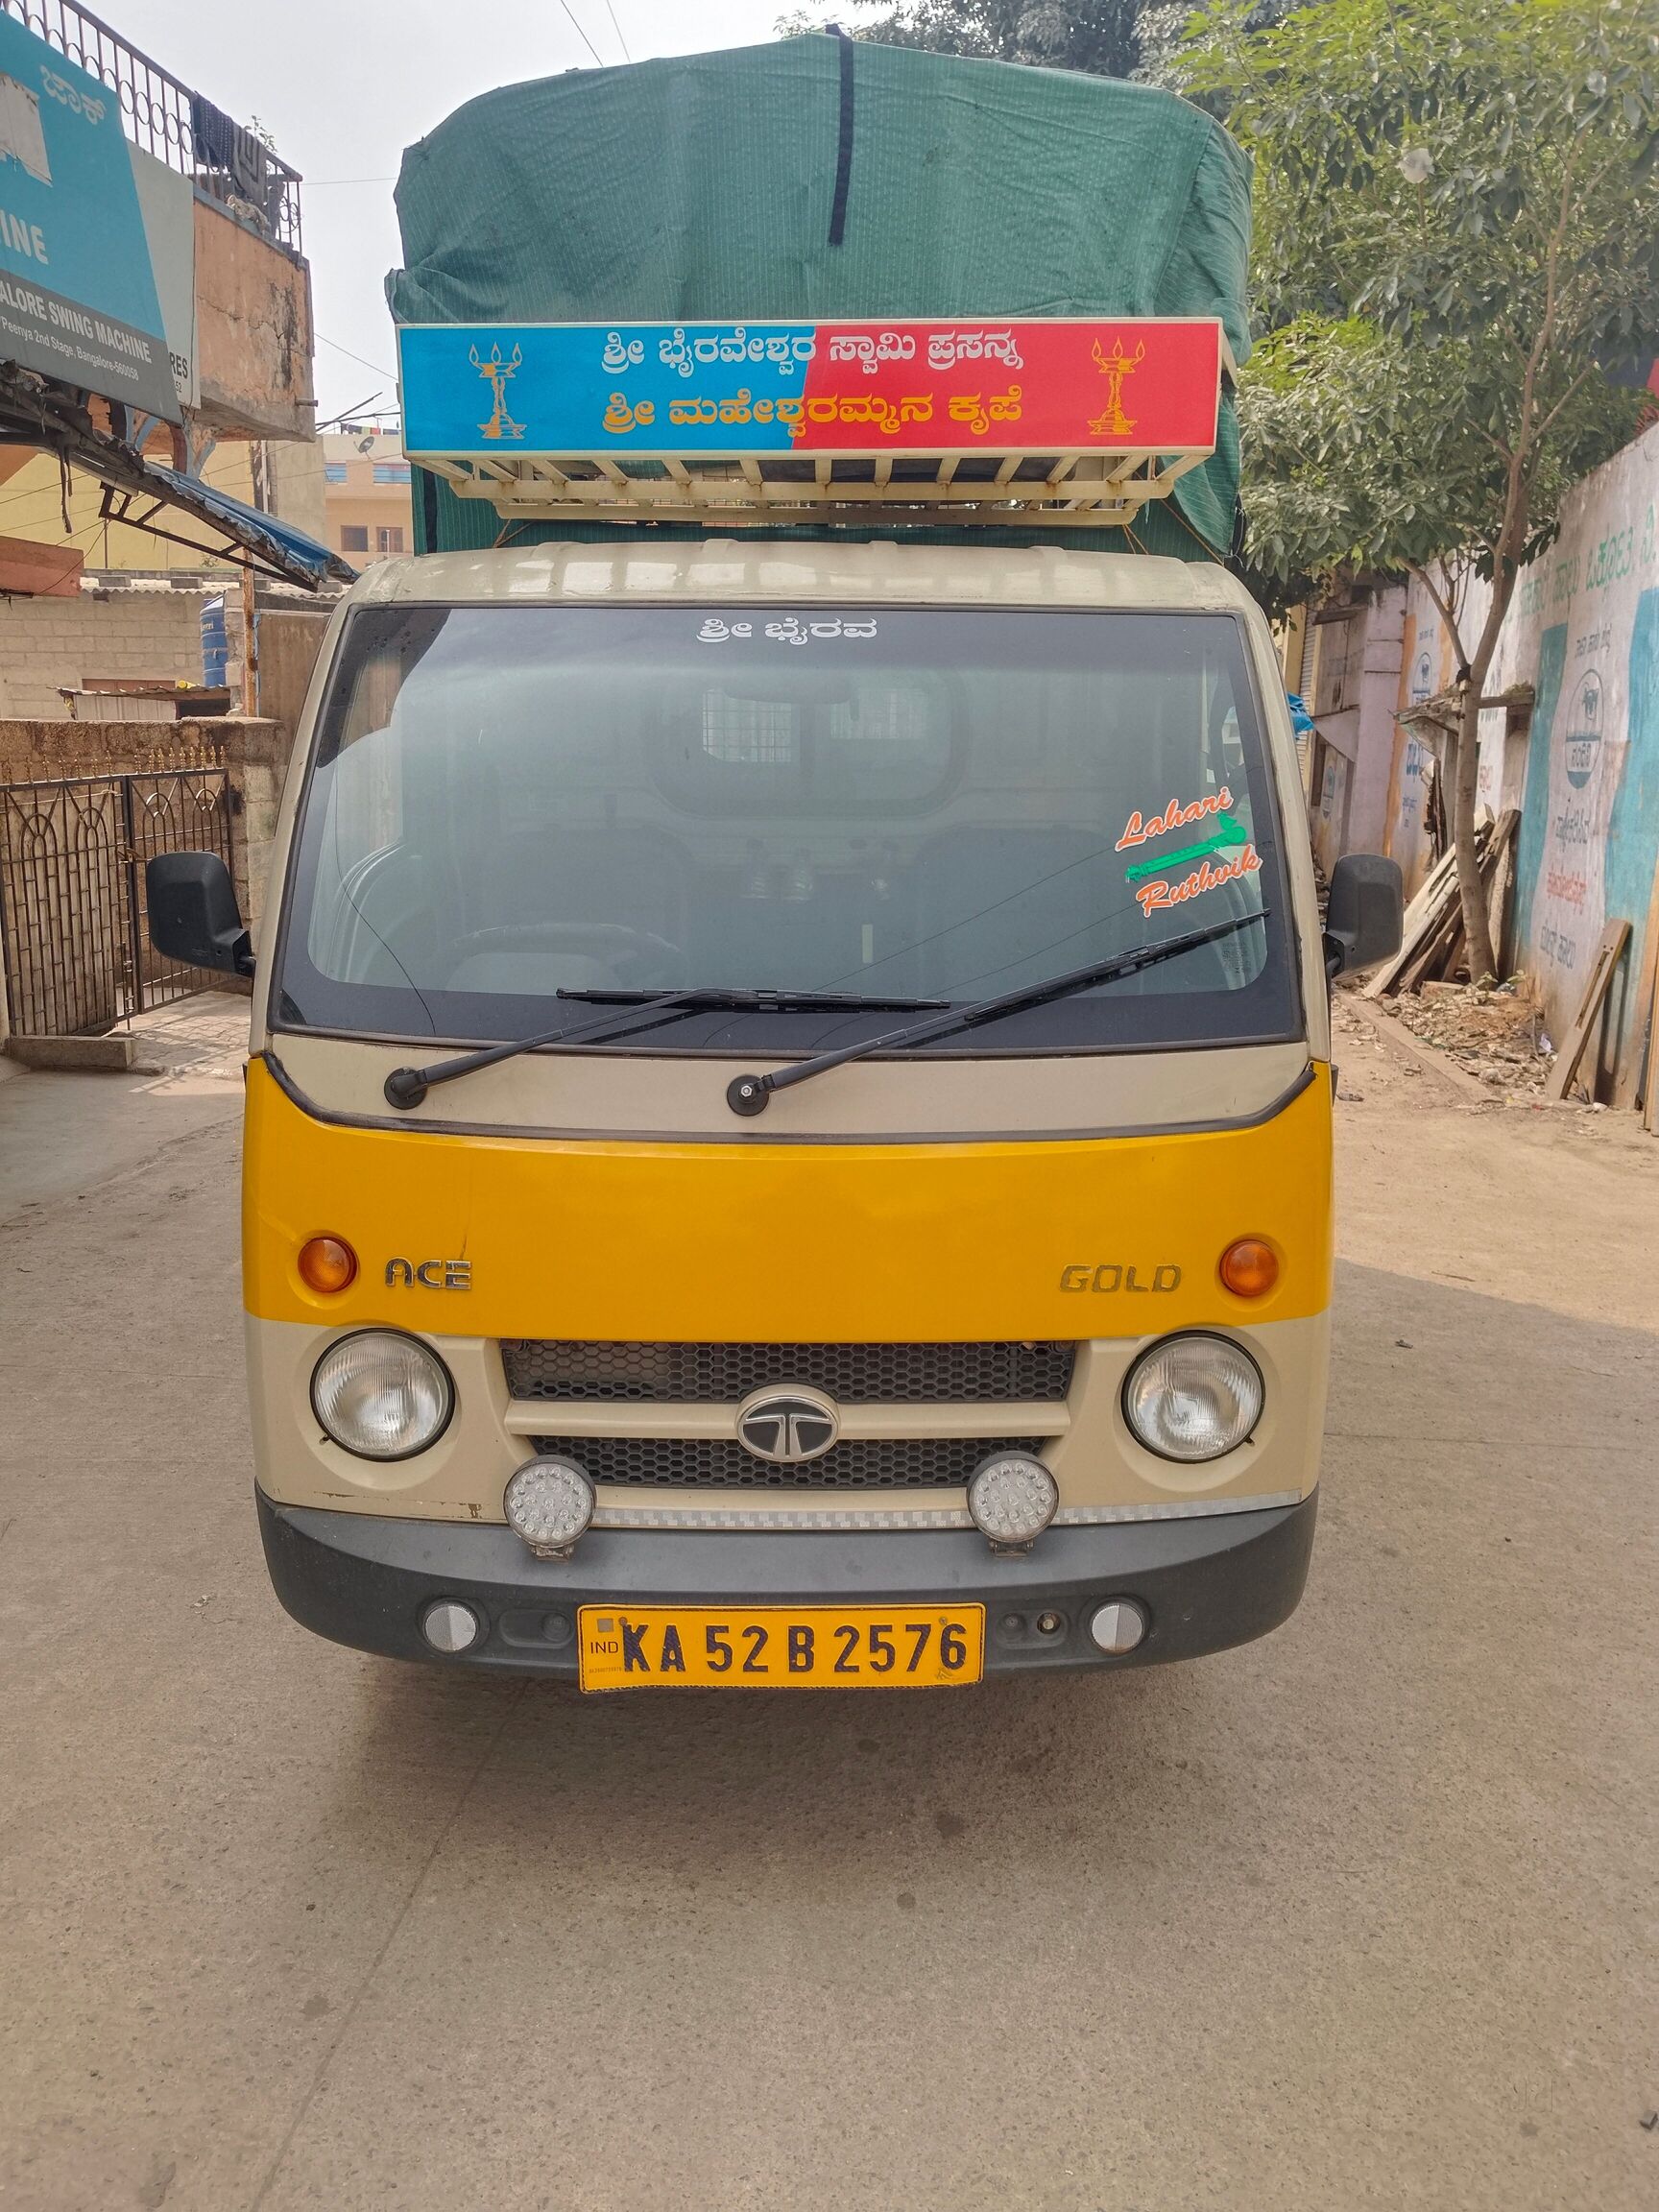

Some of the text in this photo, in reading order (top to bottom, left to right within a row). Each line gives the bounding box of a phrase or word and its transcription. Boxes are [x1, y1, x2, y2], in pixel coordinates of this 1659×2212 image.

[34, 329, 50, 348] 2nd
[50, 336, 77, 359] Stage,
[48, 301, 94, 340] SWING
[94, 320, 153, 364] MACHINE
[602, 326, 1024, 378] ಶ್ರೀ ಭೈರವೇಶ್ವರ ಸ್ವಾಮಿ ಪ್ರಸನ್ನ
[602, 384, 1022, 438] ಶ್ರೀ ಮಹೇಶ್ವರಮ್ಮನ ಕೃಪೆ
[696, 617, 878, 645] ಶ್ರೀ ಭೈರವ
[1115, 786, 1234, 852] Lahari
[1136, 844, 1263, 918] Ruthvik
[386, 1257, 471, 1289] ACE
[1059, 1263, 1182, 1292] GOLD
[590, 1641, 619, 1653] IND
[622, 1623, 967, 1672] KA 52 B 2576
